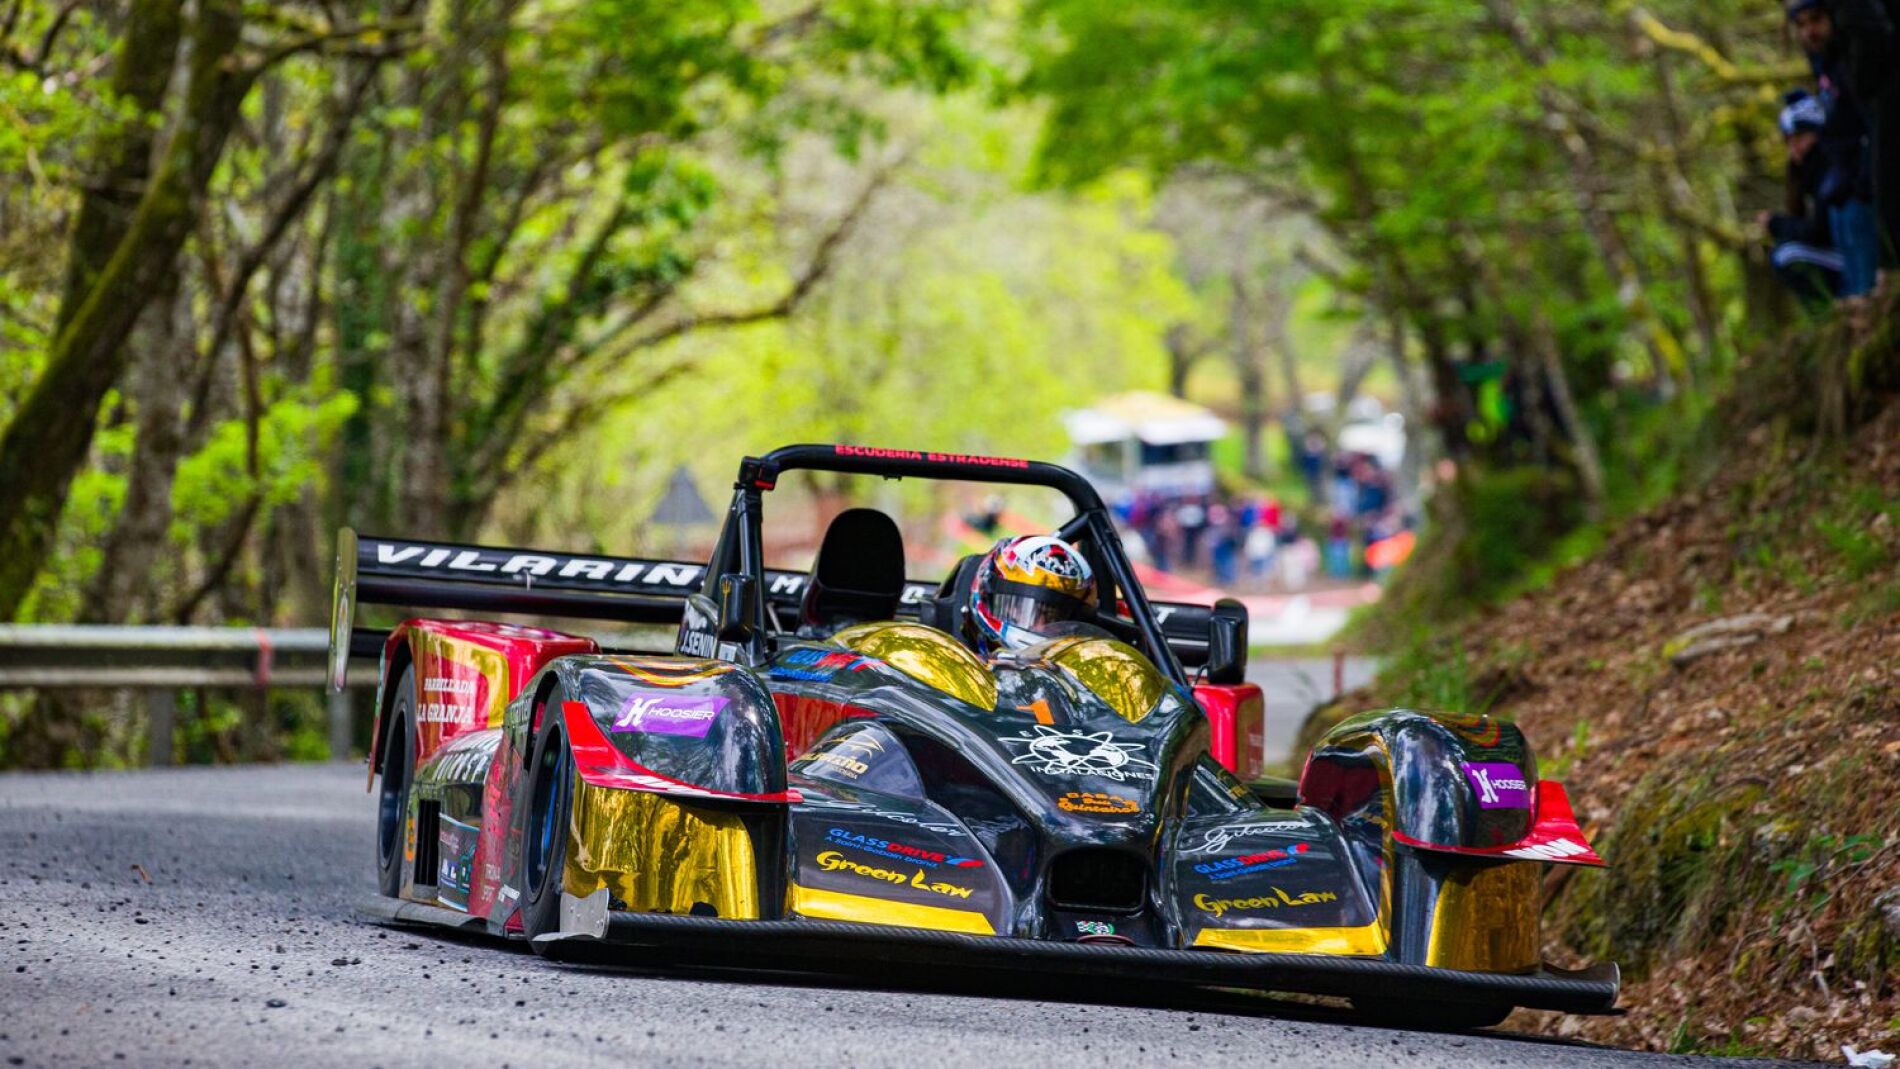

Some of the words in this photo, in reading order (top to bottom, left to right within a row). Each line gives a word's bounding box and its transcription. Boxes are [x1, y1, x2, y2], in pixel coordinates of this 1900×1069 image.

[835, 444, 922, 460] ESCUDERIA
[927, 451, 1029, 469] ESTRADENSE
[649, 706, 715, 721] HOOSIER
[829, 828, 946, 862] GLASSDRIVE
[816, 850, 907, 884] Green
[910, 868, 974, 898] Law
[1193, 893, 1279, 917] Green
[1271, 886, 1338, 907] Law
